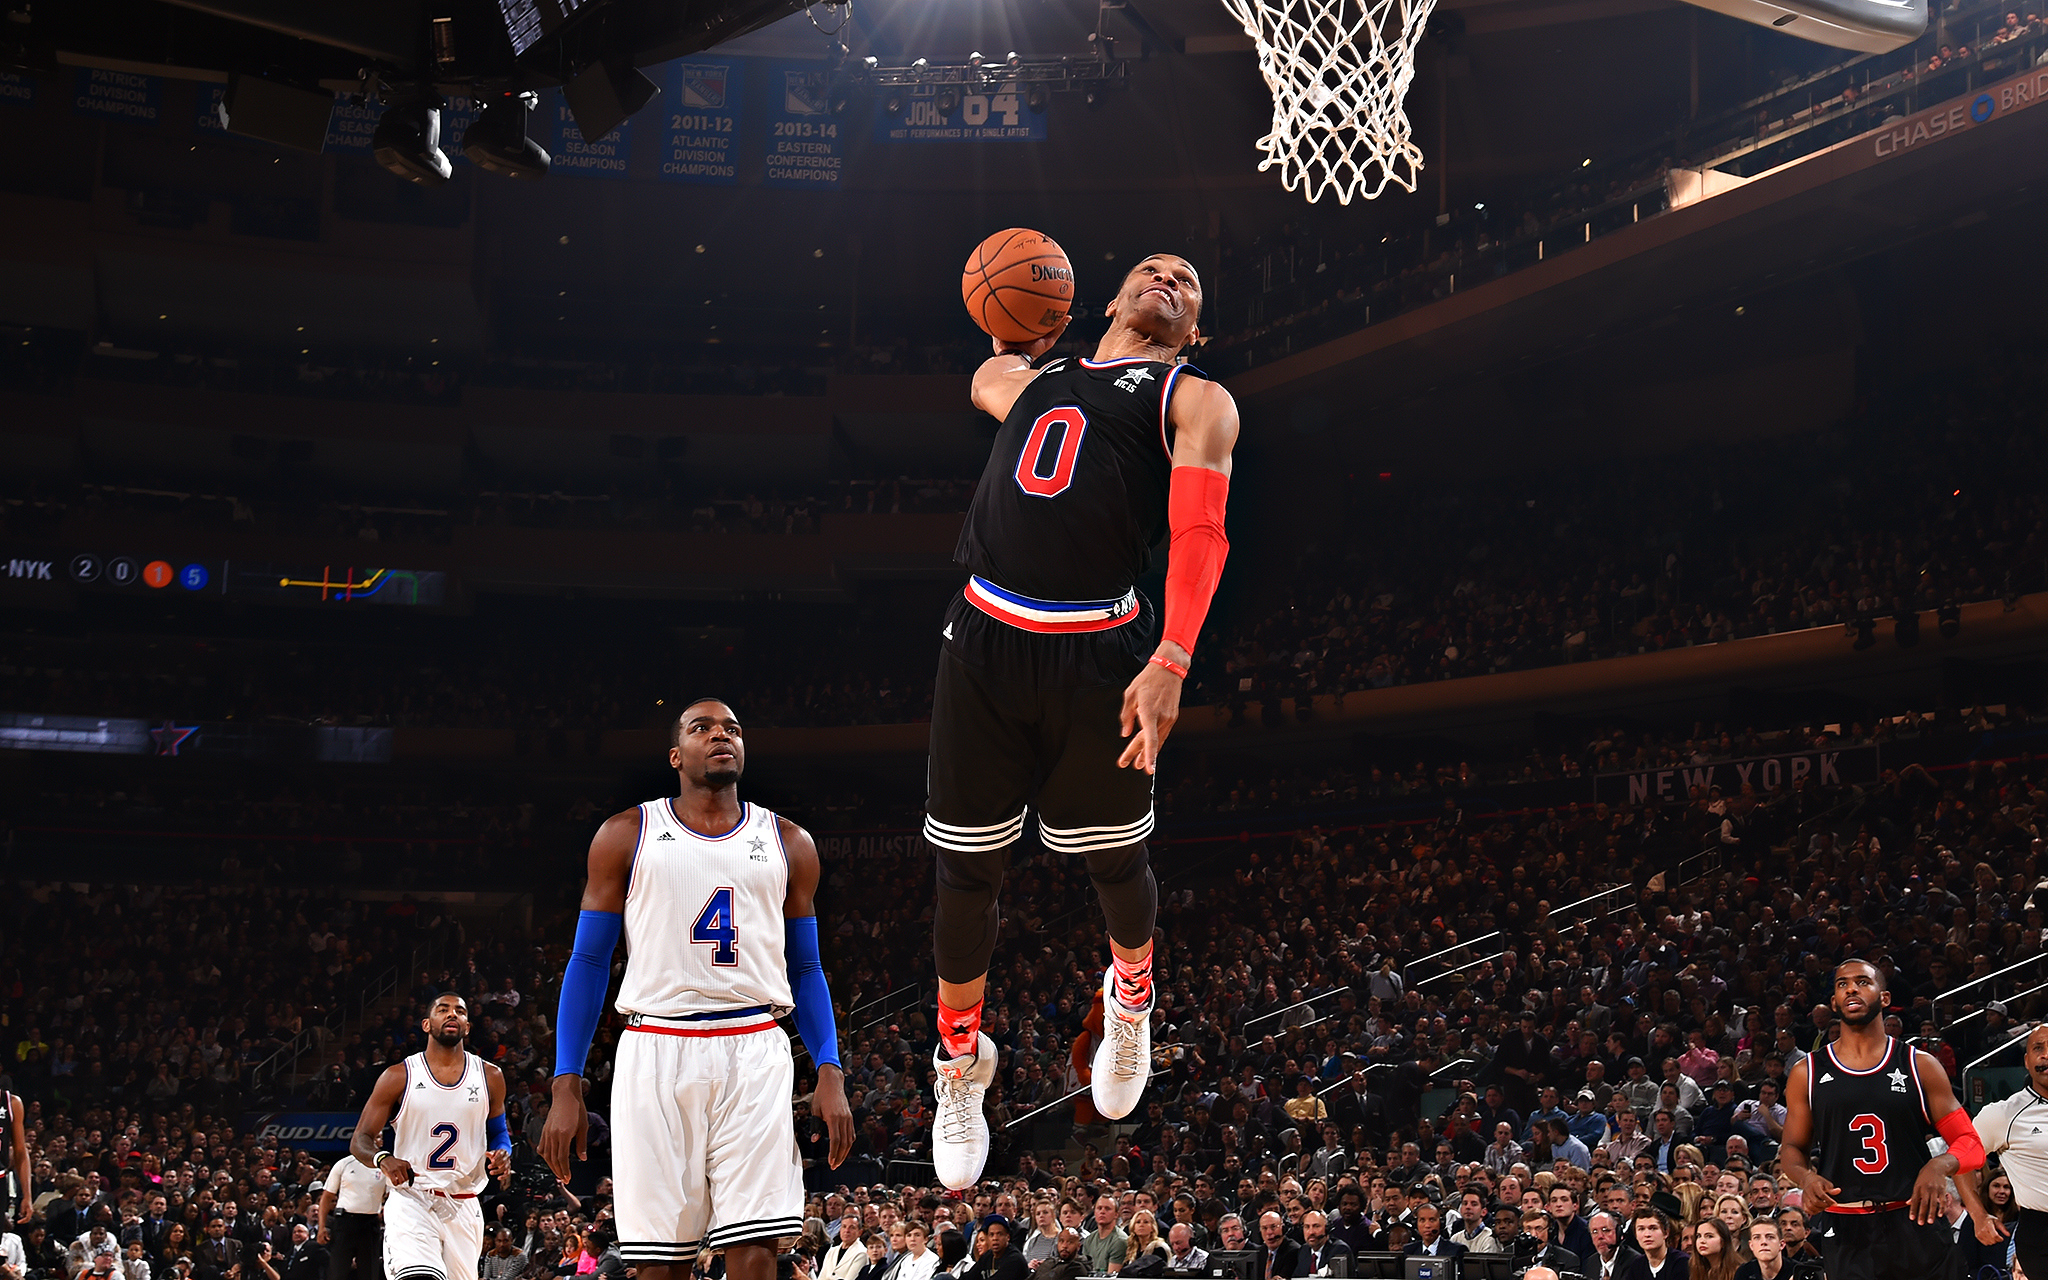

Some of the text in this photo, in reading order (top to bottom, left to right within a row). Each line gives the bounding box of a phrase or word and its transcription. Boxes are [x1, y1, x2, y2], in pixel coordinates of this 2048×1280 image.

[91, 70, 147, 88] PATRICK
[89, 84, 147, 103] DIVISION
[77, 97, 156, 119] CHAMPIONS
[335, 106, 383, 121] REGUL
[671, 114, 733, 132] 2011-12
[774, 121, 838, 138] 2013-14
[1875, 105, 1966, 157] CHASE
[327, 133, 371, 147] CHAMP
[566, 141, 616, 156] SEASON
[672, 135, 729, 149] ATLANTIC
[777, 141, 831, 154] EASTERN
[554, 154, 626, 171] CHAMPIONS
[674, 149, 726, 162] DIVISION
[766, 154, 841, 168] CONFERENCE
[663, 162, 734, 177] CHAMPIONS
[769, 168, 837, 181] CHAMPIONS
[1013, 405, 1089, 500] 0
[1628, 751, 1840, 805] NEW YORK
[817, 837, 852, 859] NBA
[690, 886, 739, 967] 4
[259, 1124, 315, 1140] BUD
[426, 1121, 461, 1171] 2
[1849, 1113, 1890, 1175] 3
